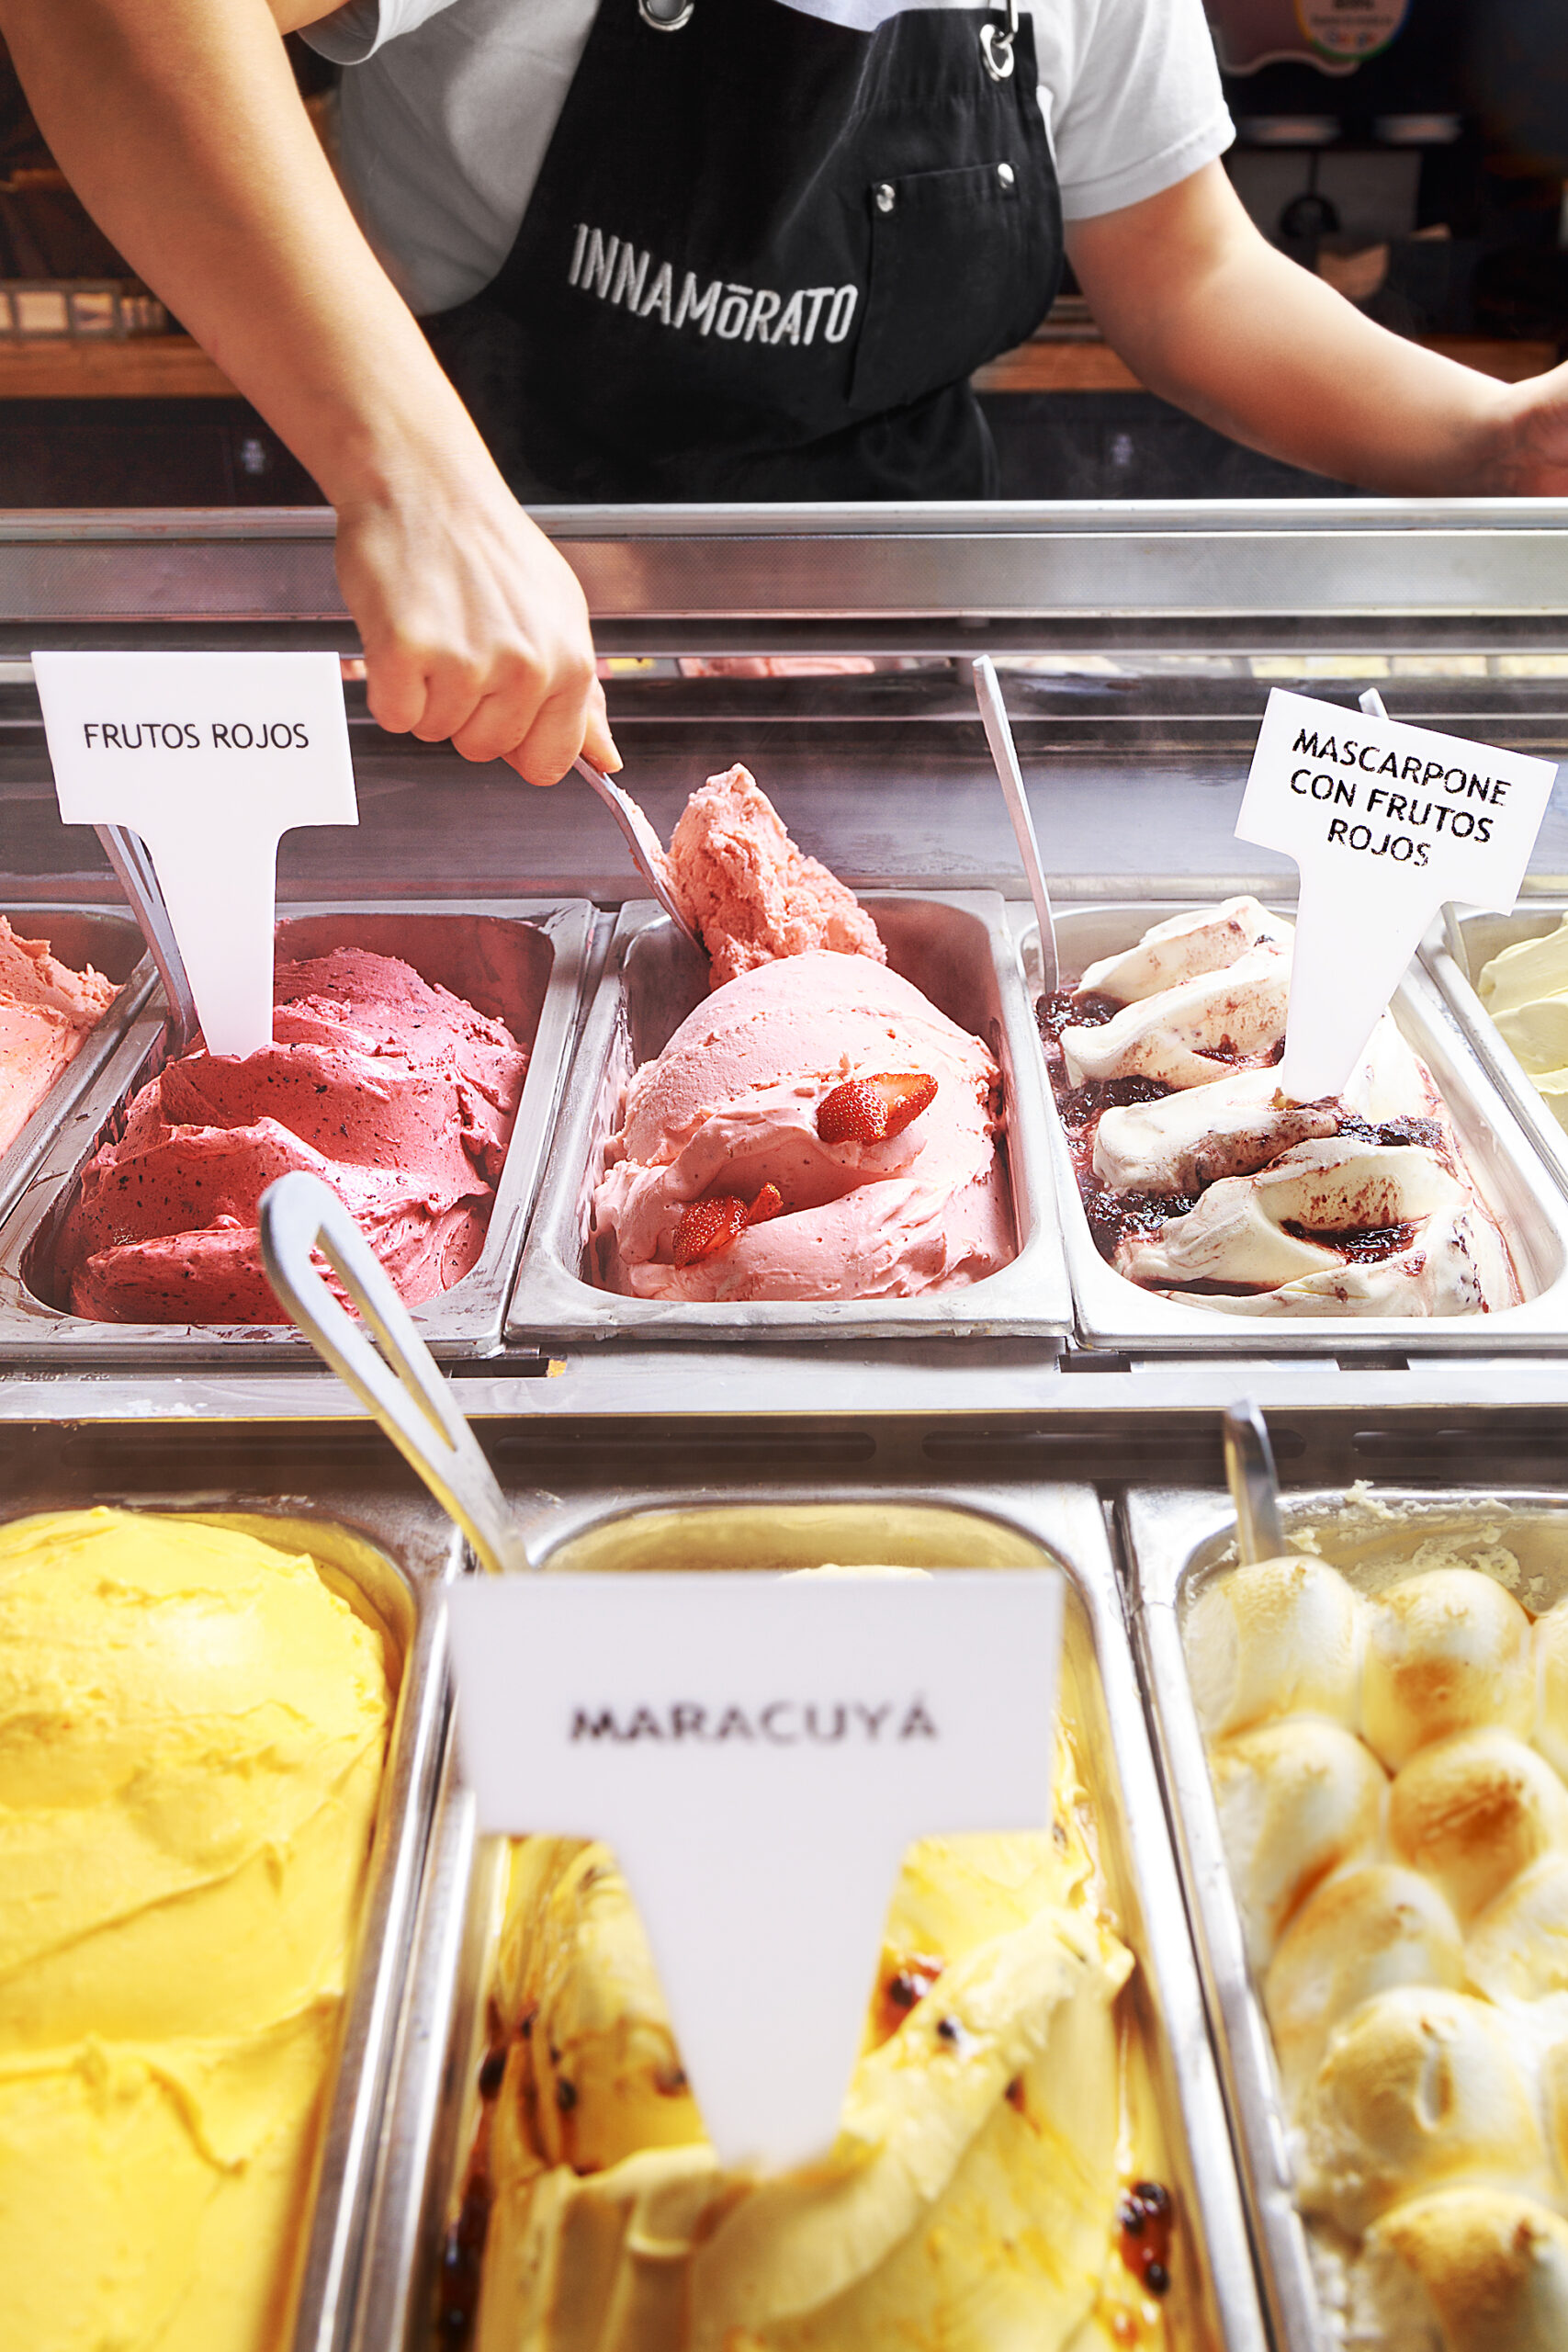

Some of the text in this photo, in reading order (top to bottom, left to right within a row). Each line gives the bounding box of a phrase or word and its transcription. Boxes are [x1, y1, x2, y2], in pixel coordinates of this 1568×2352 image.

[84, 723, 309, 749] FRUTOS ROJOS
[1292, 729, 1512, 806] MASCARPONE
[1291, 769, 1494, 842] CON FRUTOS
[1327, 819, 1431, 866] ROJOS
[570, 1692, 938, 1746] MARACUYÁ
